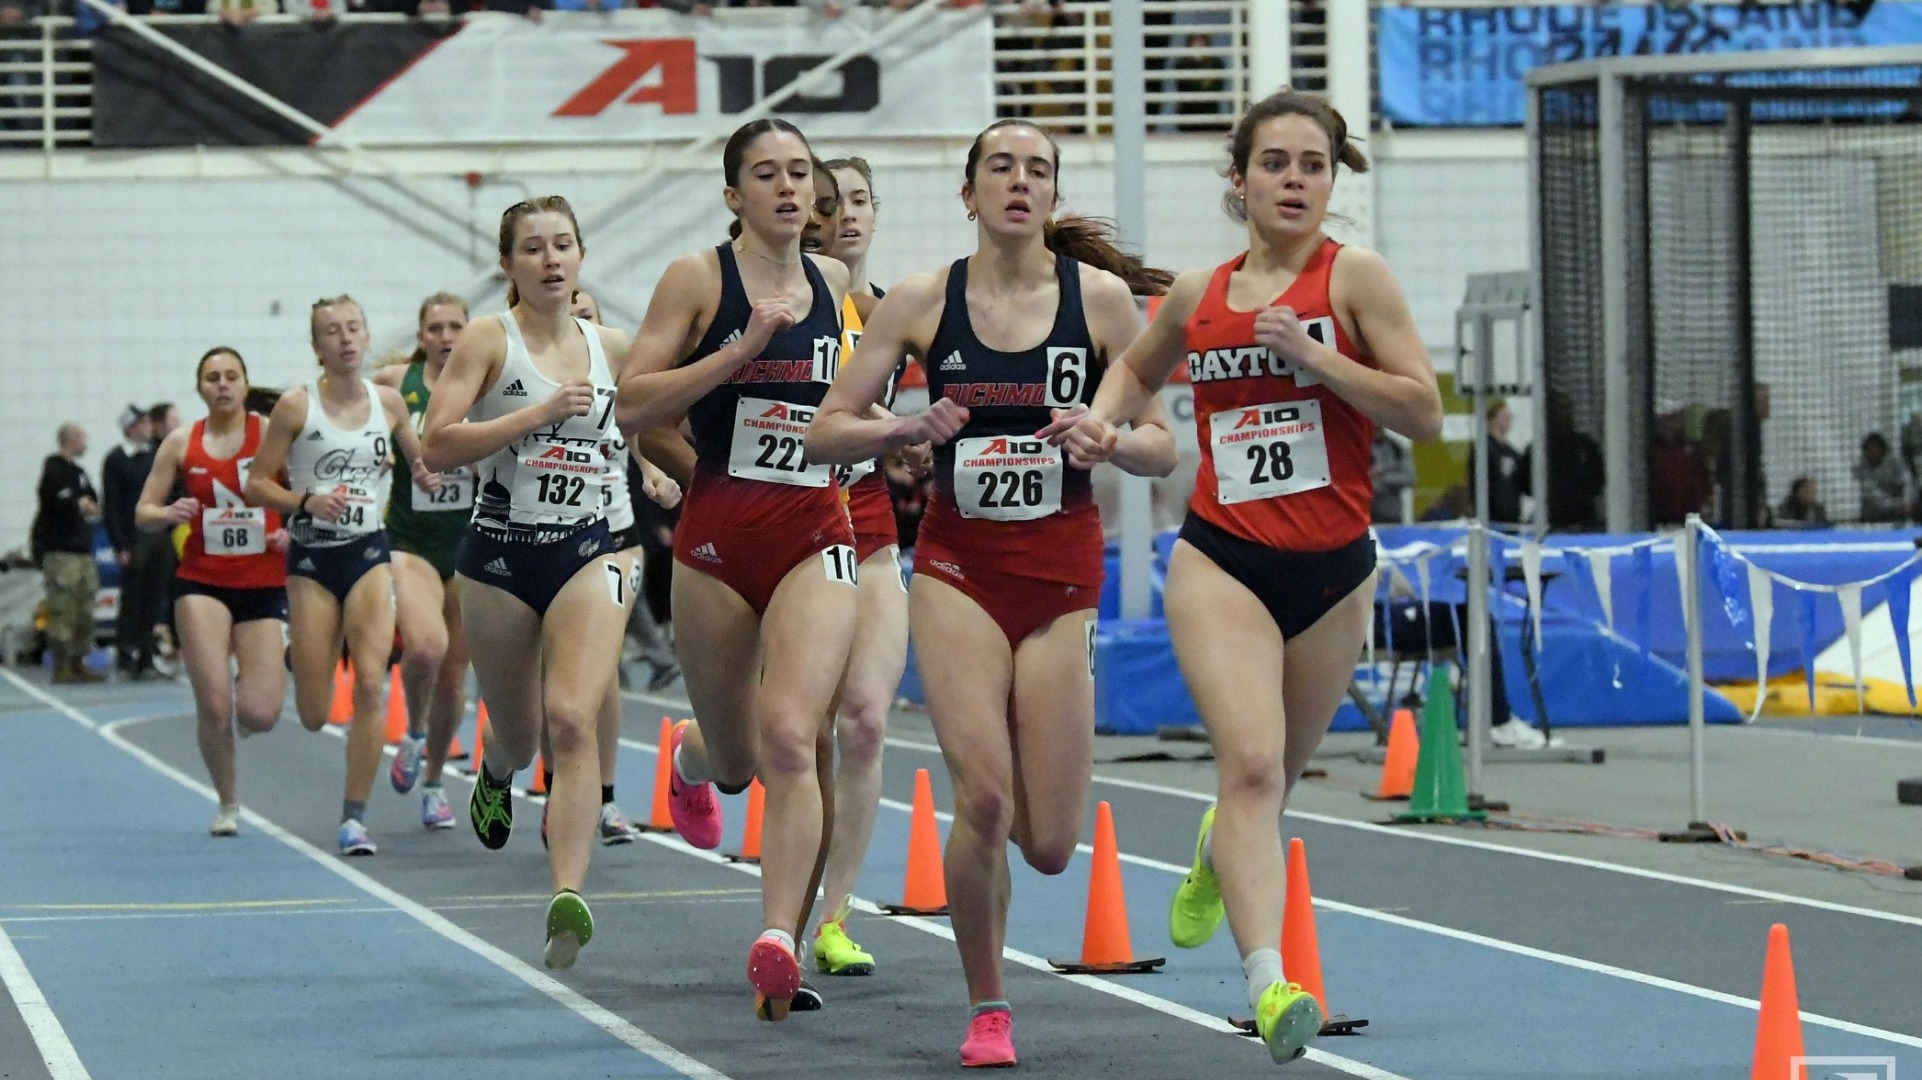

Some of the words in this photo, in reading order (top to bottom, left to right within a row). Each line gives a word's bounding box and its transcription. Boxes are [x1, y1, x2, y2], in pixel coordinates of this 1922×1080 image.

[550, 37, 880, 117] A10
[939, 363, 967, 371] adidas
[1051, 352, 1080, 404] 6
[596, 388, 616, 431] 7
[760, 403, 815, 424] A10
[1233, 407, 1300, 429] A10
[1219, 423, 1315, 445] CHAMPIONSHIPS
[373, 437, 387, 466] 9
[539, 446, 591, 464] A10
[979, 438, 1043, 456] A10
[524, 458, 600, 475] CHAMPIONSHIPS
[963, 457, 1056, 468] CHAMPIONSHIPS
[1247, 441, 1294, 485] 28
[537, 473, 586, 507] 132
[977, 470, 1044, 508] 226
[223, 528, 248, 548] 68
[827, 545, 858, 586] 10
[606, 564, 624, 605] 7
